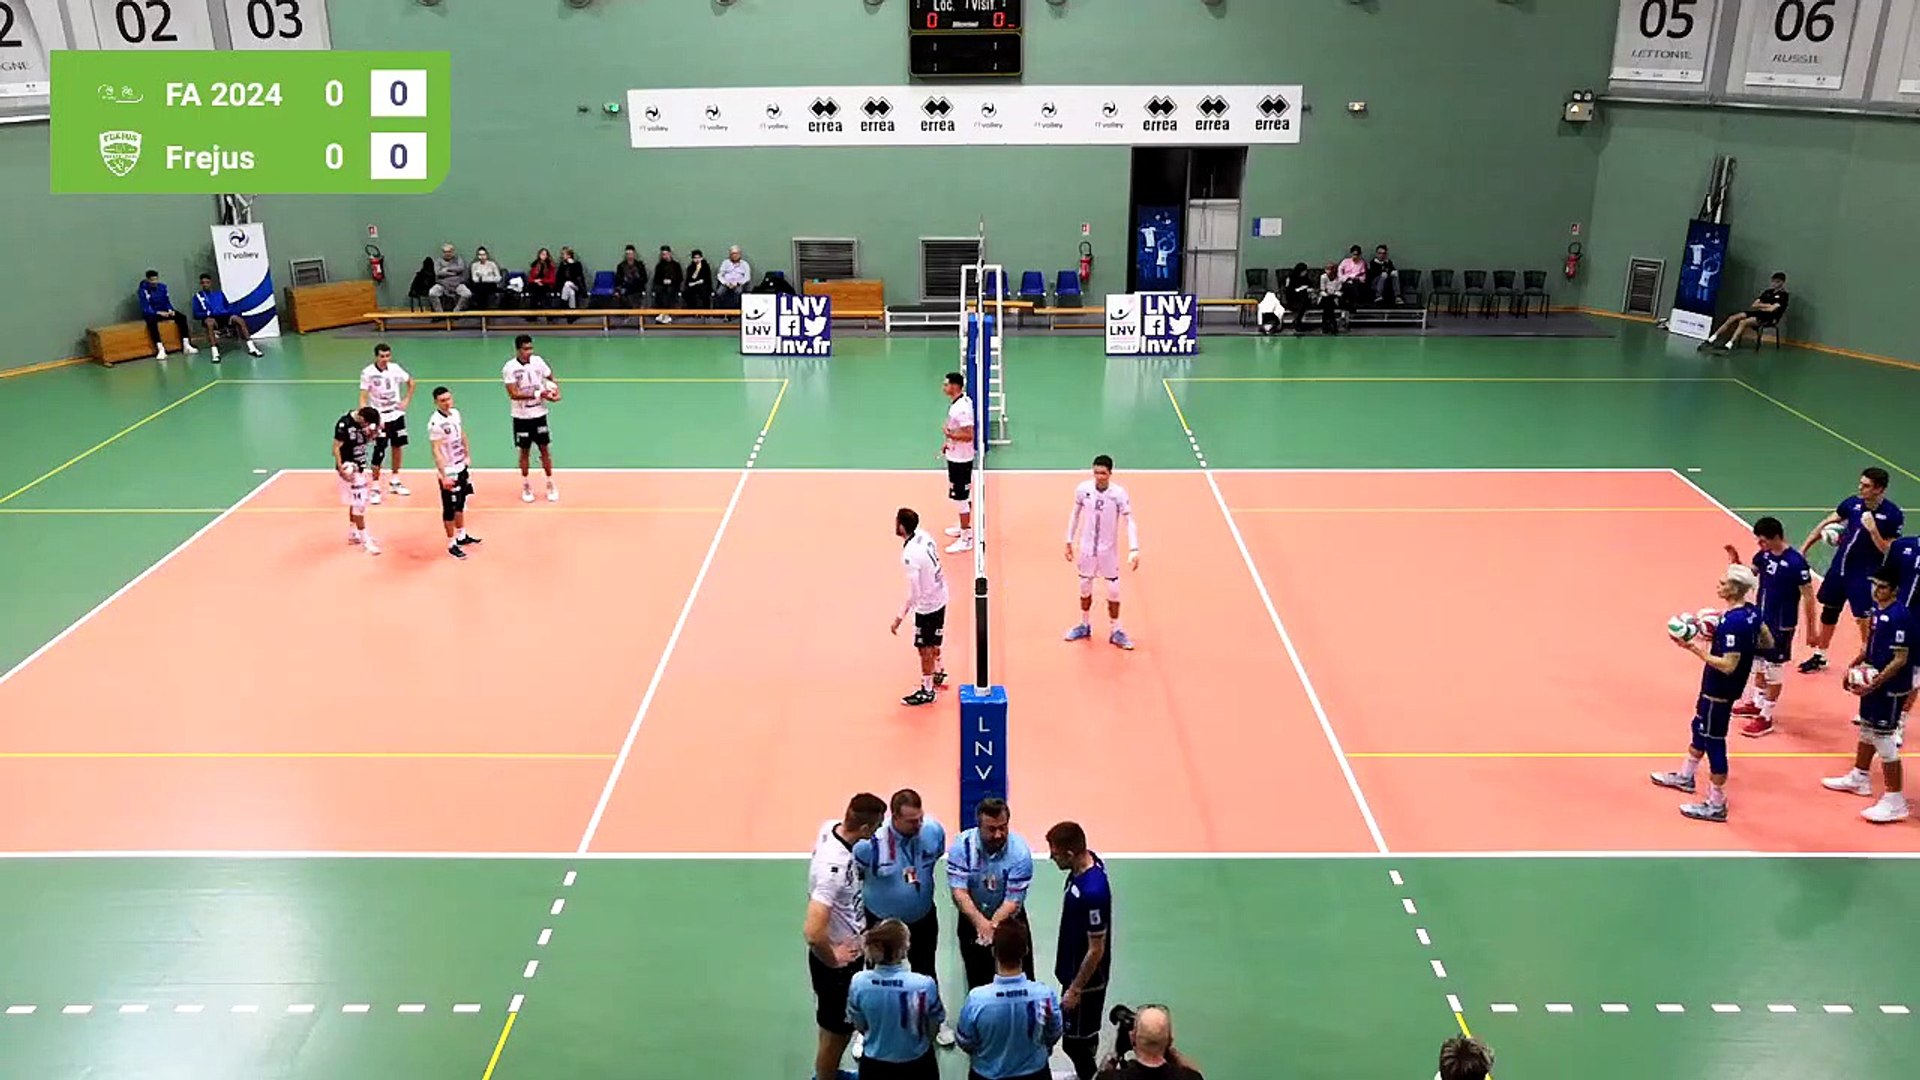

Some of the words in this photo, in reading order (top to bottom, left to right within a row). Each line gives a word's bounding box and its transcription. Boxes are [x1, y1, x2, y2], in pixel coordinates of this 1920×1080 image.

[114, 0, 178, 43] 02
[246, 0, 304, 39] 03
[926, 11, 939, 29] 0
[992, 11, 1006, 28] 0
[1638, 0, 1697, 39] 05
[1773, 0, 1836, 42] 06
[1630, 48, 1693, 60] LETTONIE
[1772, 53, 1821, 65] RUSSIE
[808, 119, 843, 133] errea
[860, 119, 895, 132] errea
[919, 119, 955, 132] errea
[1142, 118, 1178, 132] errea
[1194, 118, 1230, 131] errea
[1254, 118, 1290, 131] errea
[780, 296, 827, 315] LNV
[1145, 295, 1192, 315] LNV
[745, 325, 771, 336] LNV
[1110, 325, 1136, 336] LNV
[775, 335, 831, 354] lnv.fr
[1140, 334, 1196, 353] lnv.fr
